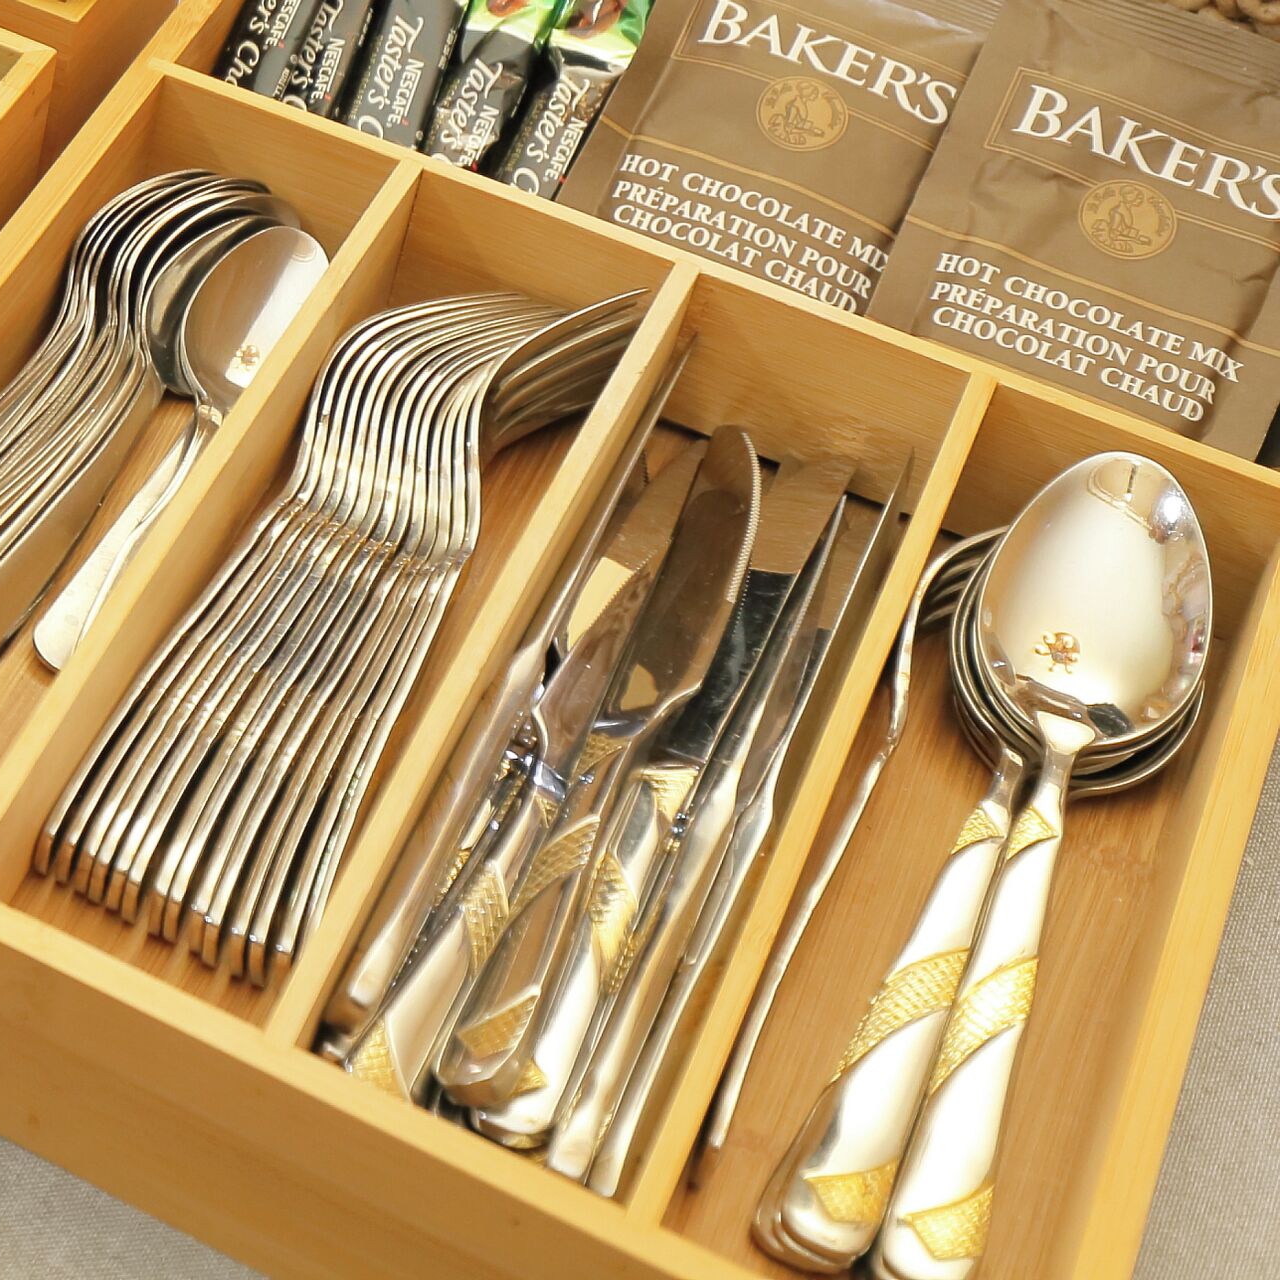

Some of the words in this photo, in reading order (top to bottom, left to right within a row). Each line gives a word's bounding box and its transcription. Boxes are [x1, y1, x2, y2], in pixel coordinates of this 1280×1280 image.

[369, 13, 424, 111] Taster's
[439, 56, 504, 148] Taster's
[525, 76, 590, 166] Taster's
[1011, 84, 1280, 220] BAKER'S
[611, 180, 798, 259] PRÉPARATION
[799, 247, 874, 299] POUR
[619, 154, 679, 182] HOT
[682, 172, 848, 250] CHOCOLATE
[612, 204, 763, 269] CHOCOLAT
[764, 258, 858, 314] CHAUD
[930, 281, 1134, 366] PRÉPARATION
[1136, 352, 1217, 404] POUR
[933, 306, 1096, 377] CHOCOLAT
[1100, 367, 1206, 422] CHAUD
[936, 253, 1001, 285] HOT
[1004, 275, 1187, 357] CHOCOLATE
[1190, 341, 1245, 384] MIX
